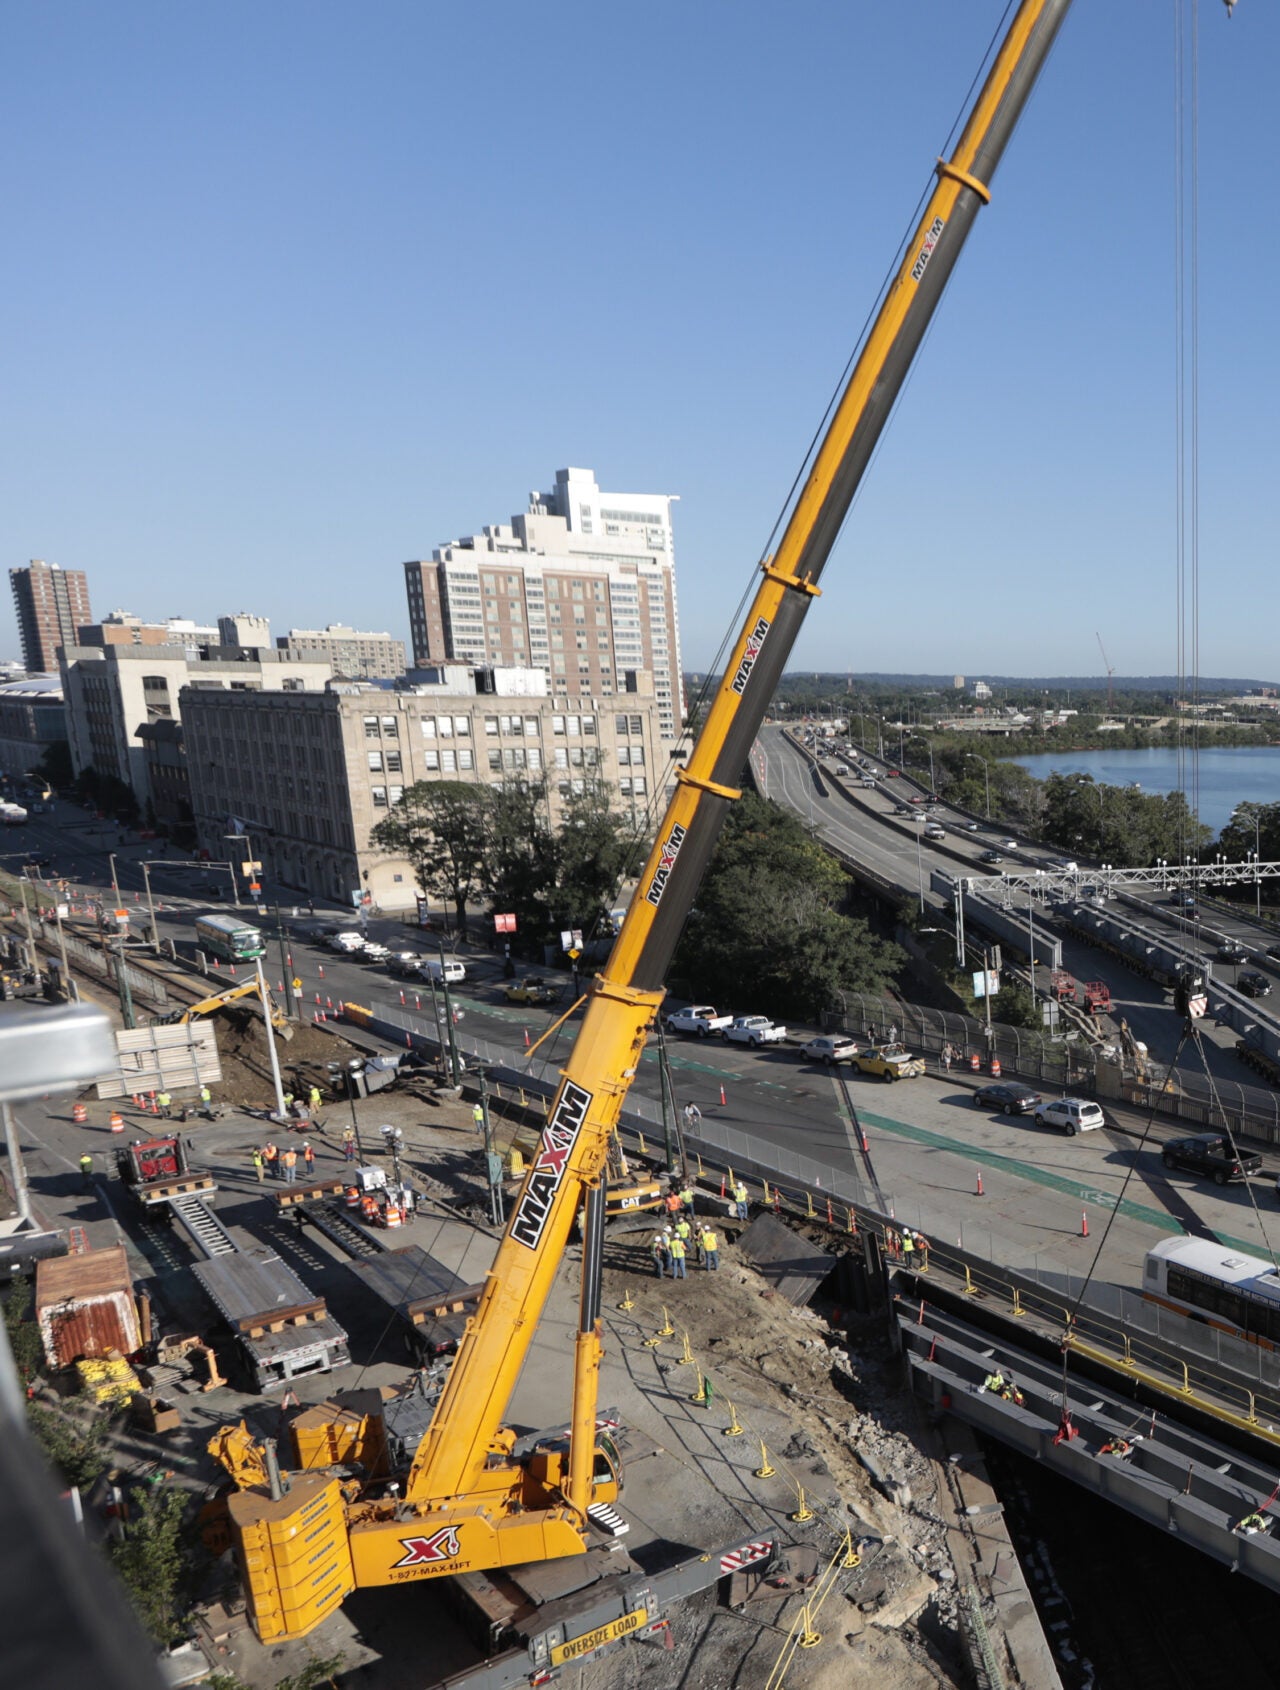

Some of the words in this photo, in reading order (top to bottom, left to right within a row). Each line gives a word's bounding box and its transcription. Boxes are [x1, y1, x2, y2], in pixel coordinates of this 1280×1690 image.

[732, 618, 769, 693] MAXIM
[647, 825, 685, 905] MAXIM
[511, 1080, 593, 1249] MAXIM
[621, 1195, 641, 1210] CAT
[562, 1627, 609, 1659] OVERSIZE
[612, 1615, 638, 1637] LOAD
